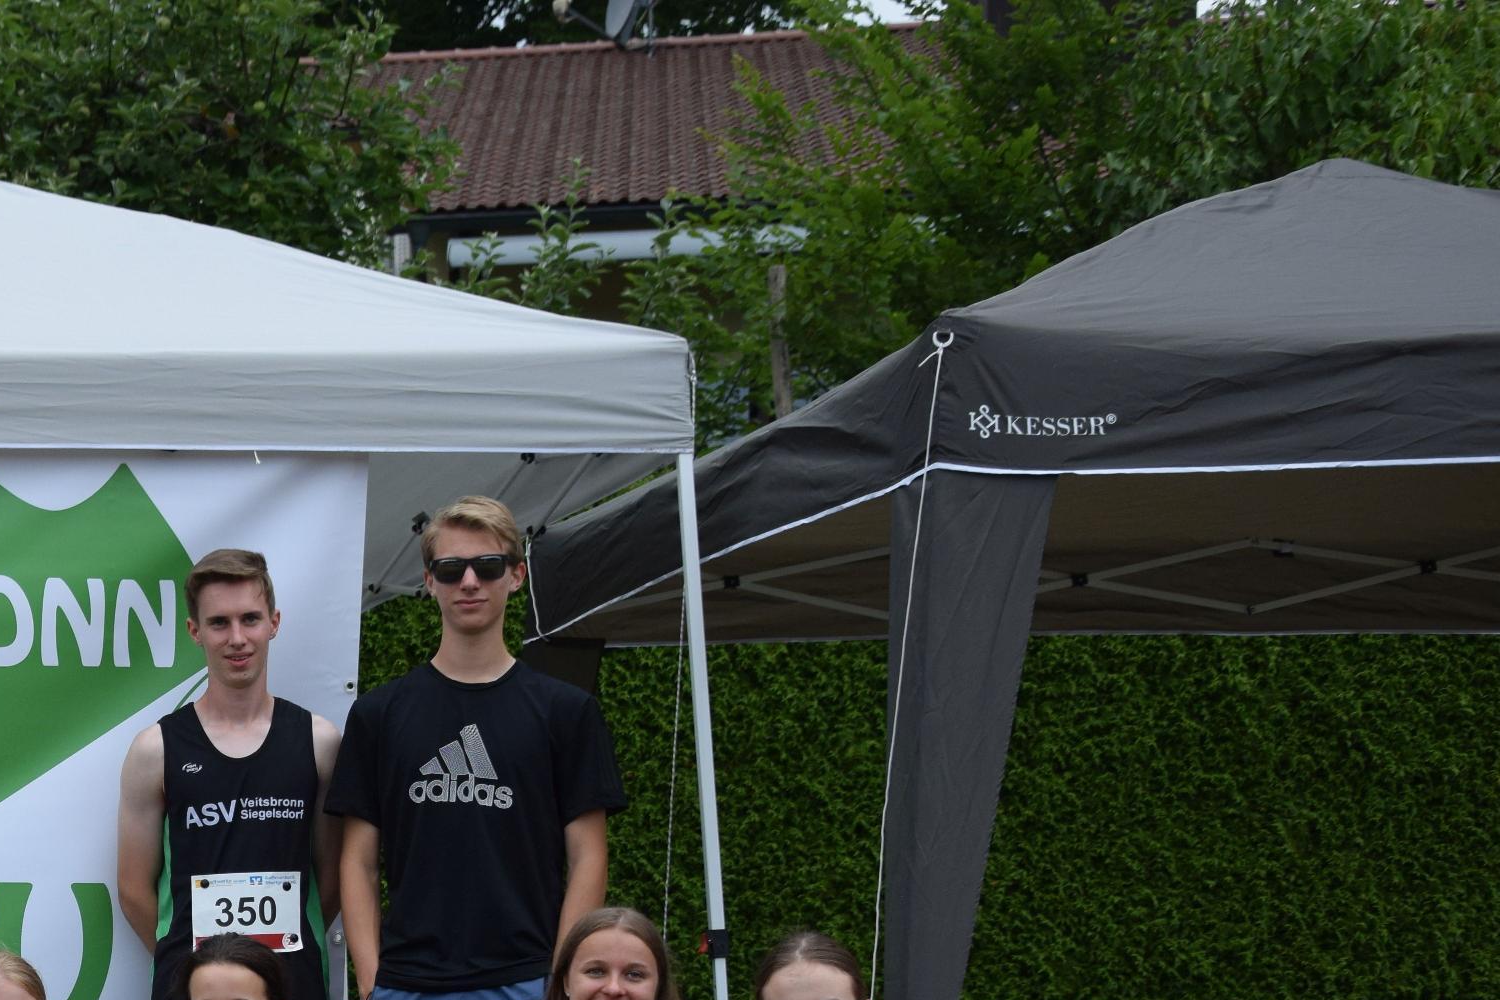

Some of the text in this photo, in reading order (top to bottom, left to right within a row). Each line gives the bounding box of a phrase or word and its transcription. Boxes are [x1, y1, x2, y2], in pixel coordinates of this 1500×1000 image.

[408, 773, 514, 810] adidas
[186, 797, 304, 829] ASV Veitsbronn
[240, 808, 305, 821] Siegelsdorf
[215, 896, 277, 927] 350
